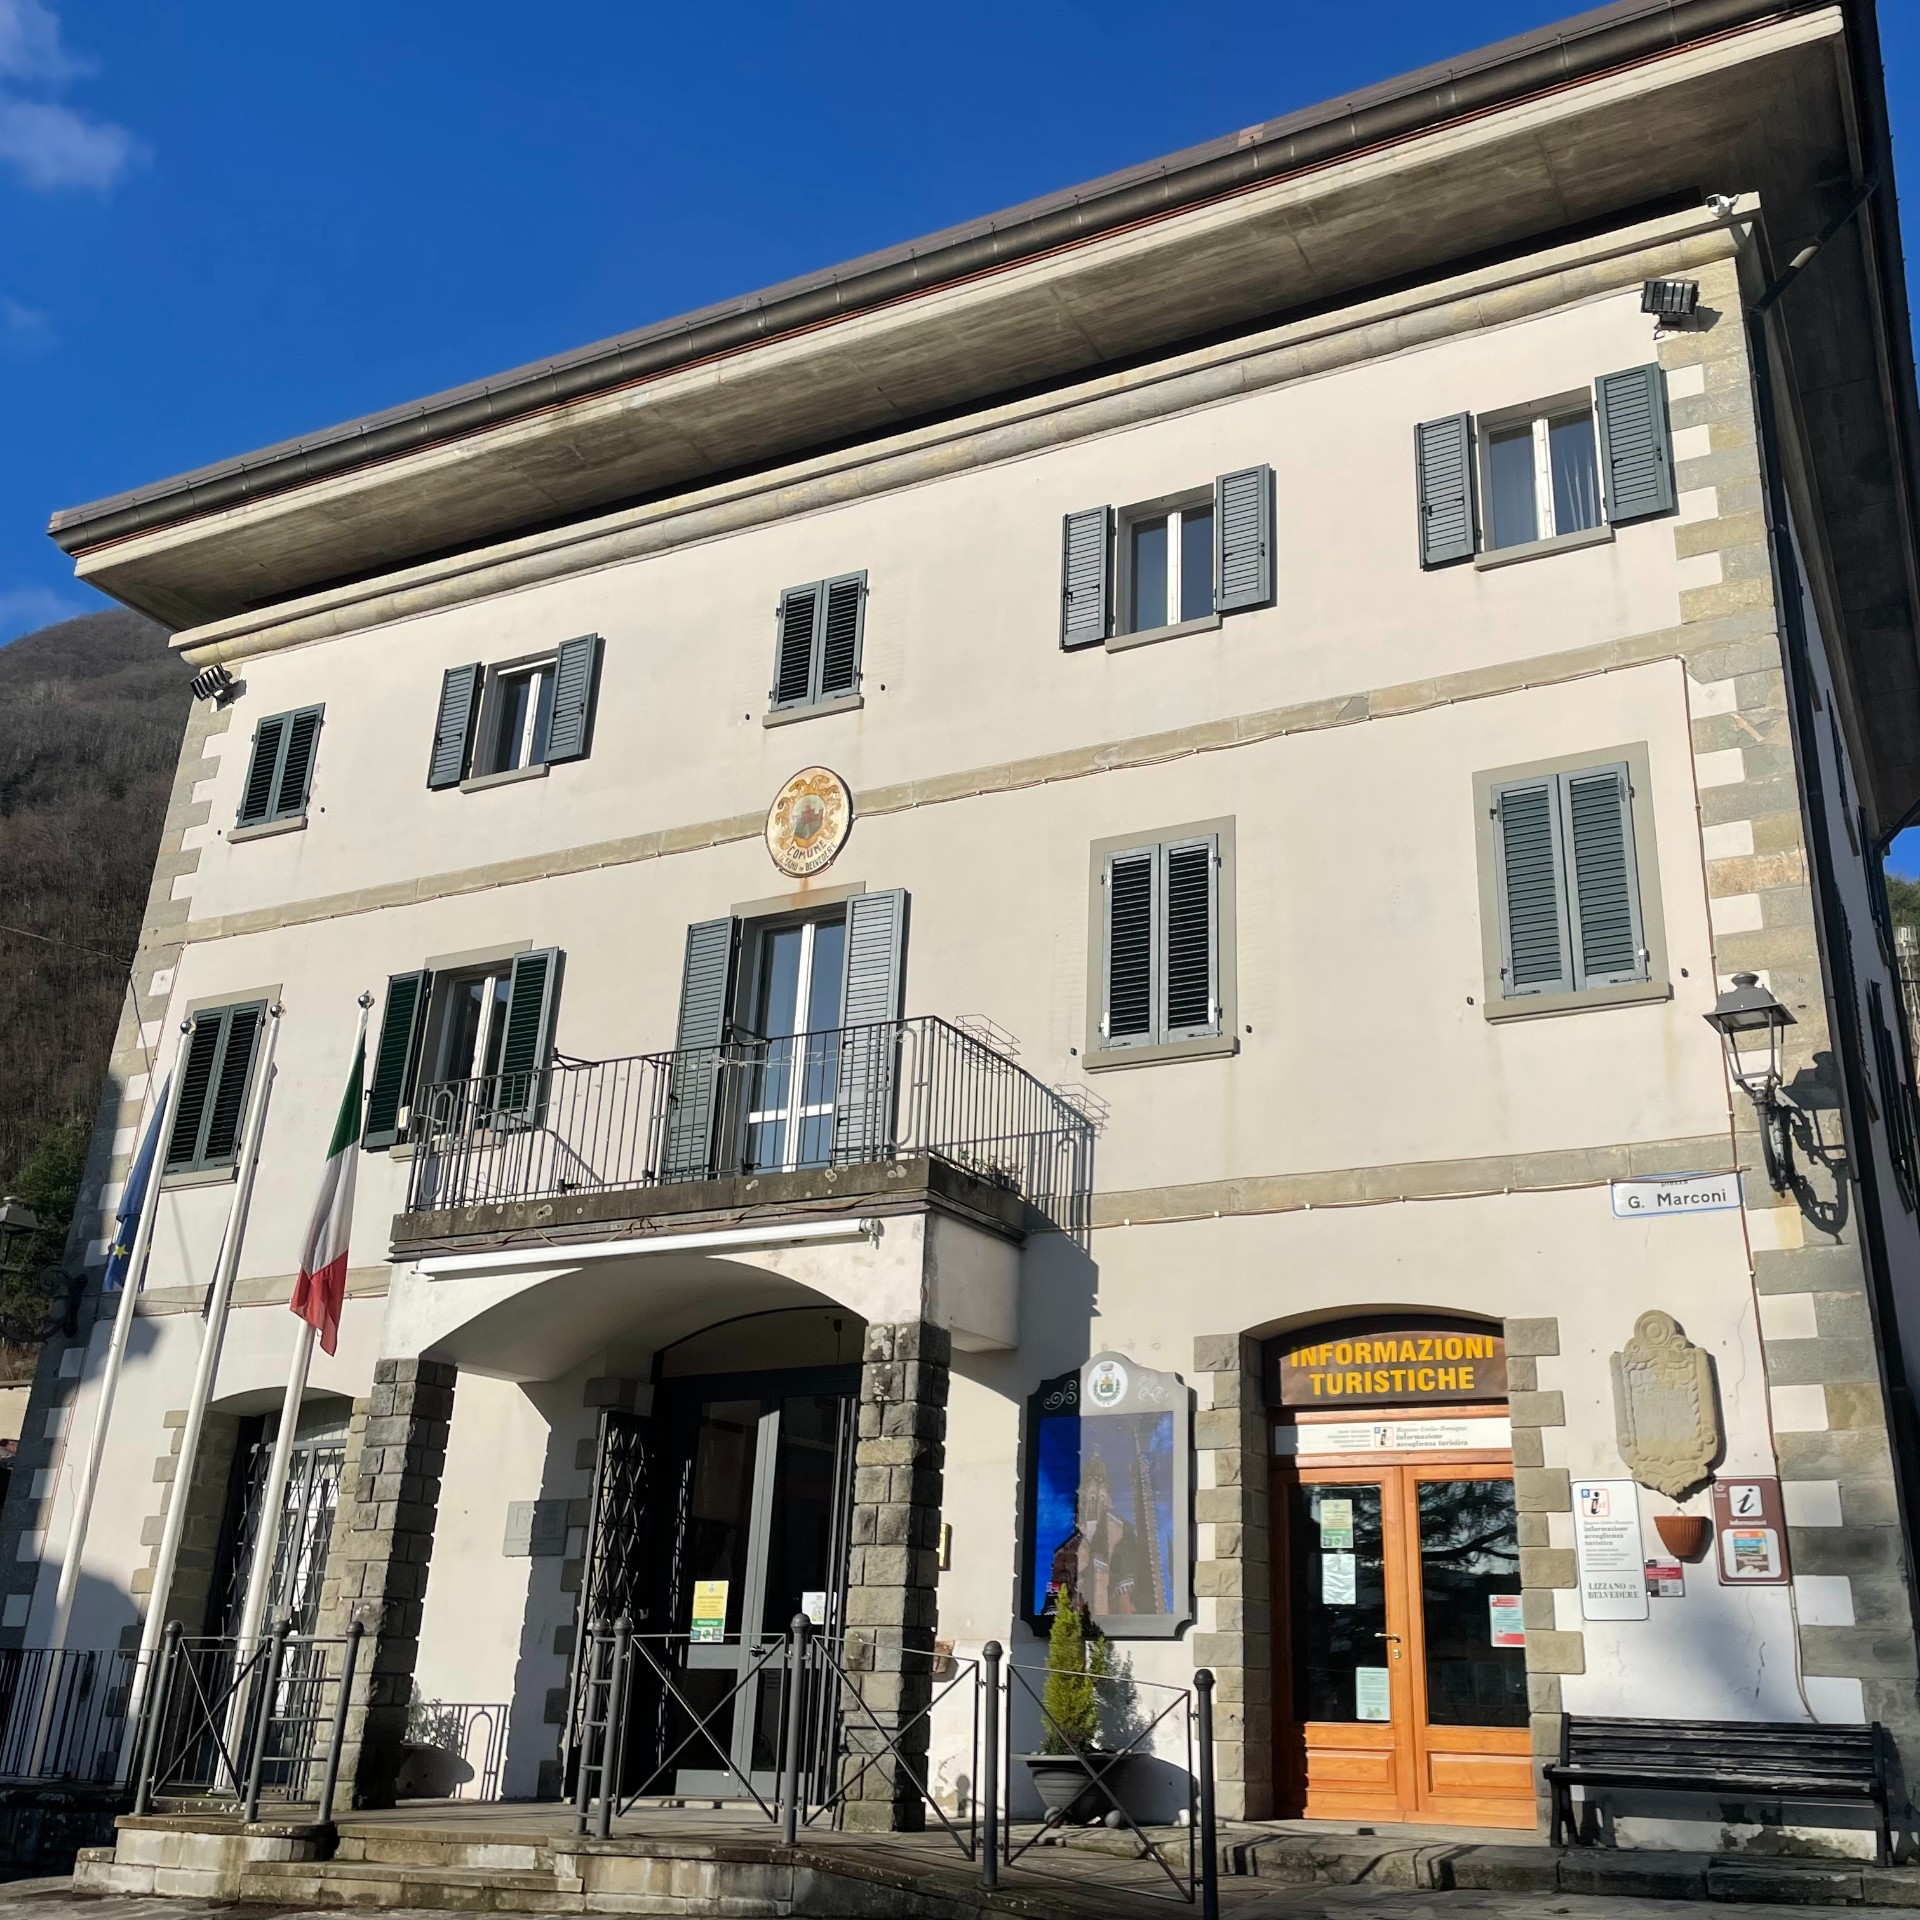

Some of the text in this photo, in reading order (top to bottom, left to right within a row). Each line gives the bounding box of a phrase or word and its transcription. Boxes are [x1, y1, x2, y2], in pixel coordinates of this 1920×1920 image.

[787, 840, 827, 860] COMUNE
[1628, 1189, 1727, 1209] G. Marconi
[1290, 1336, 1495, 1368] INFORMAZIONI
[1309, 1366, 1475, 1396] TURISTICHE
[1588, 1582, 1626, 1590] LIZZANO
[1588, 1590, 1640, 1599] BELVEDERE
